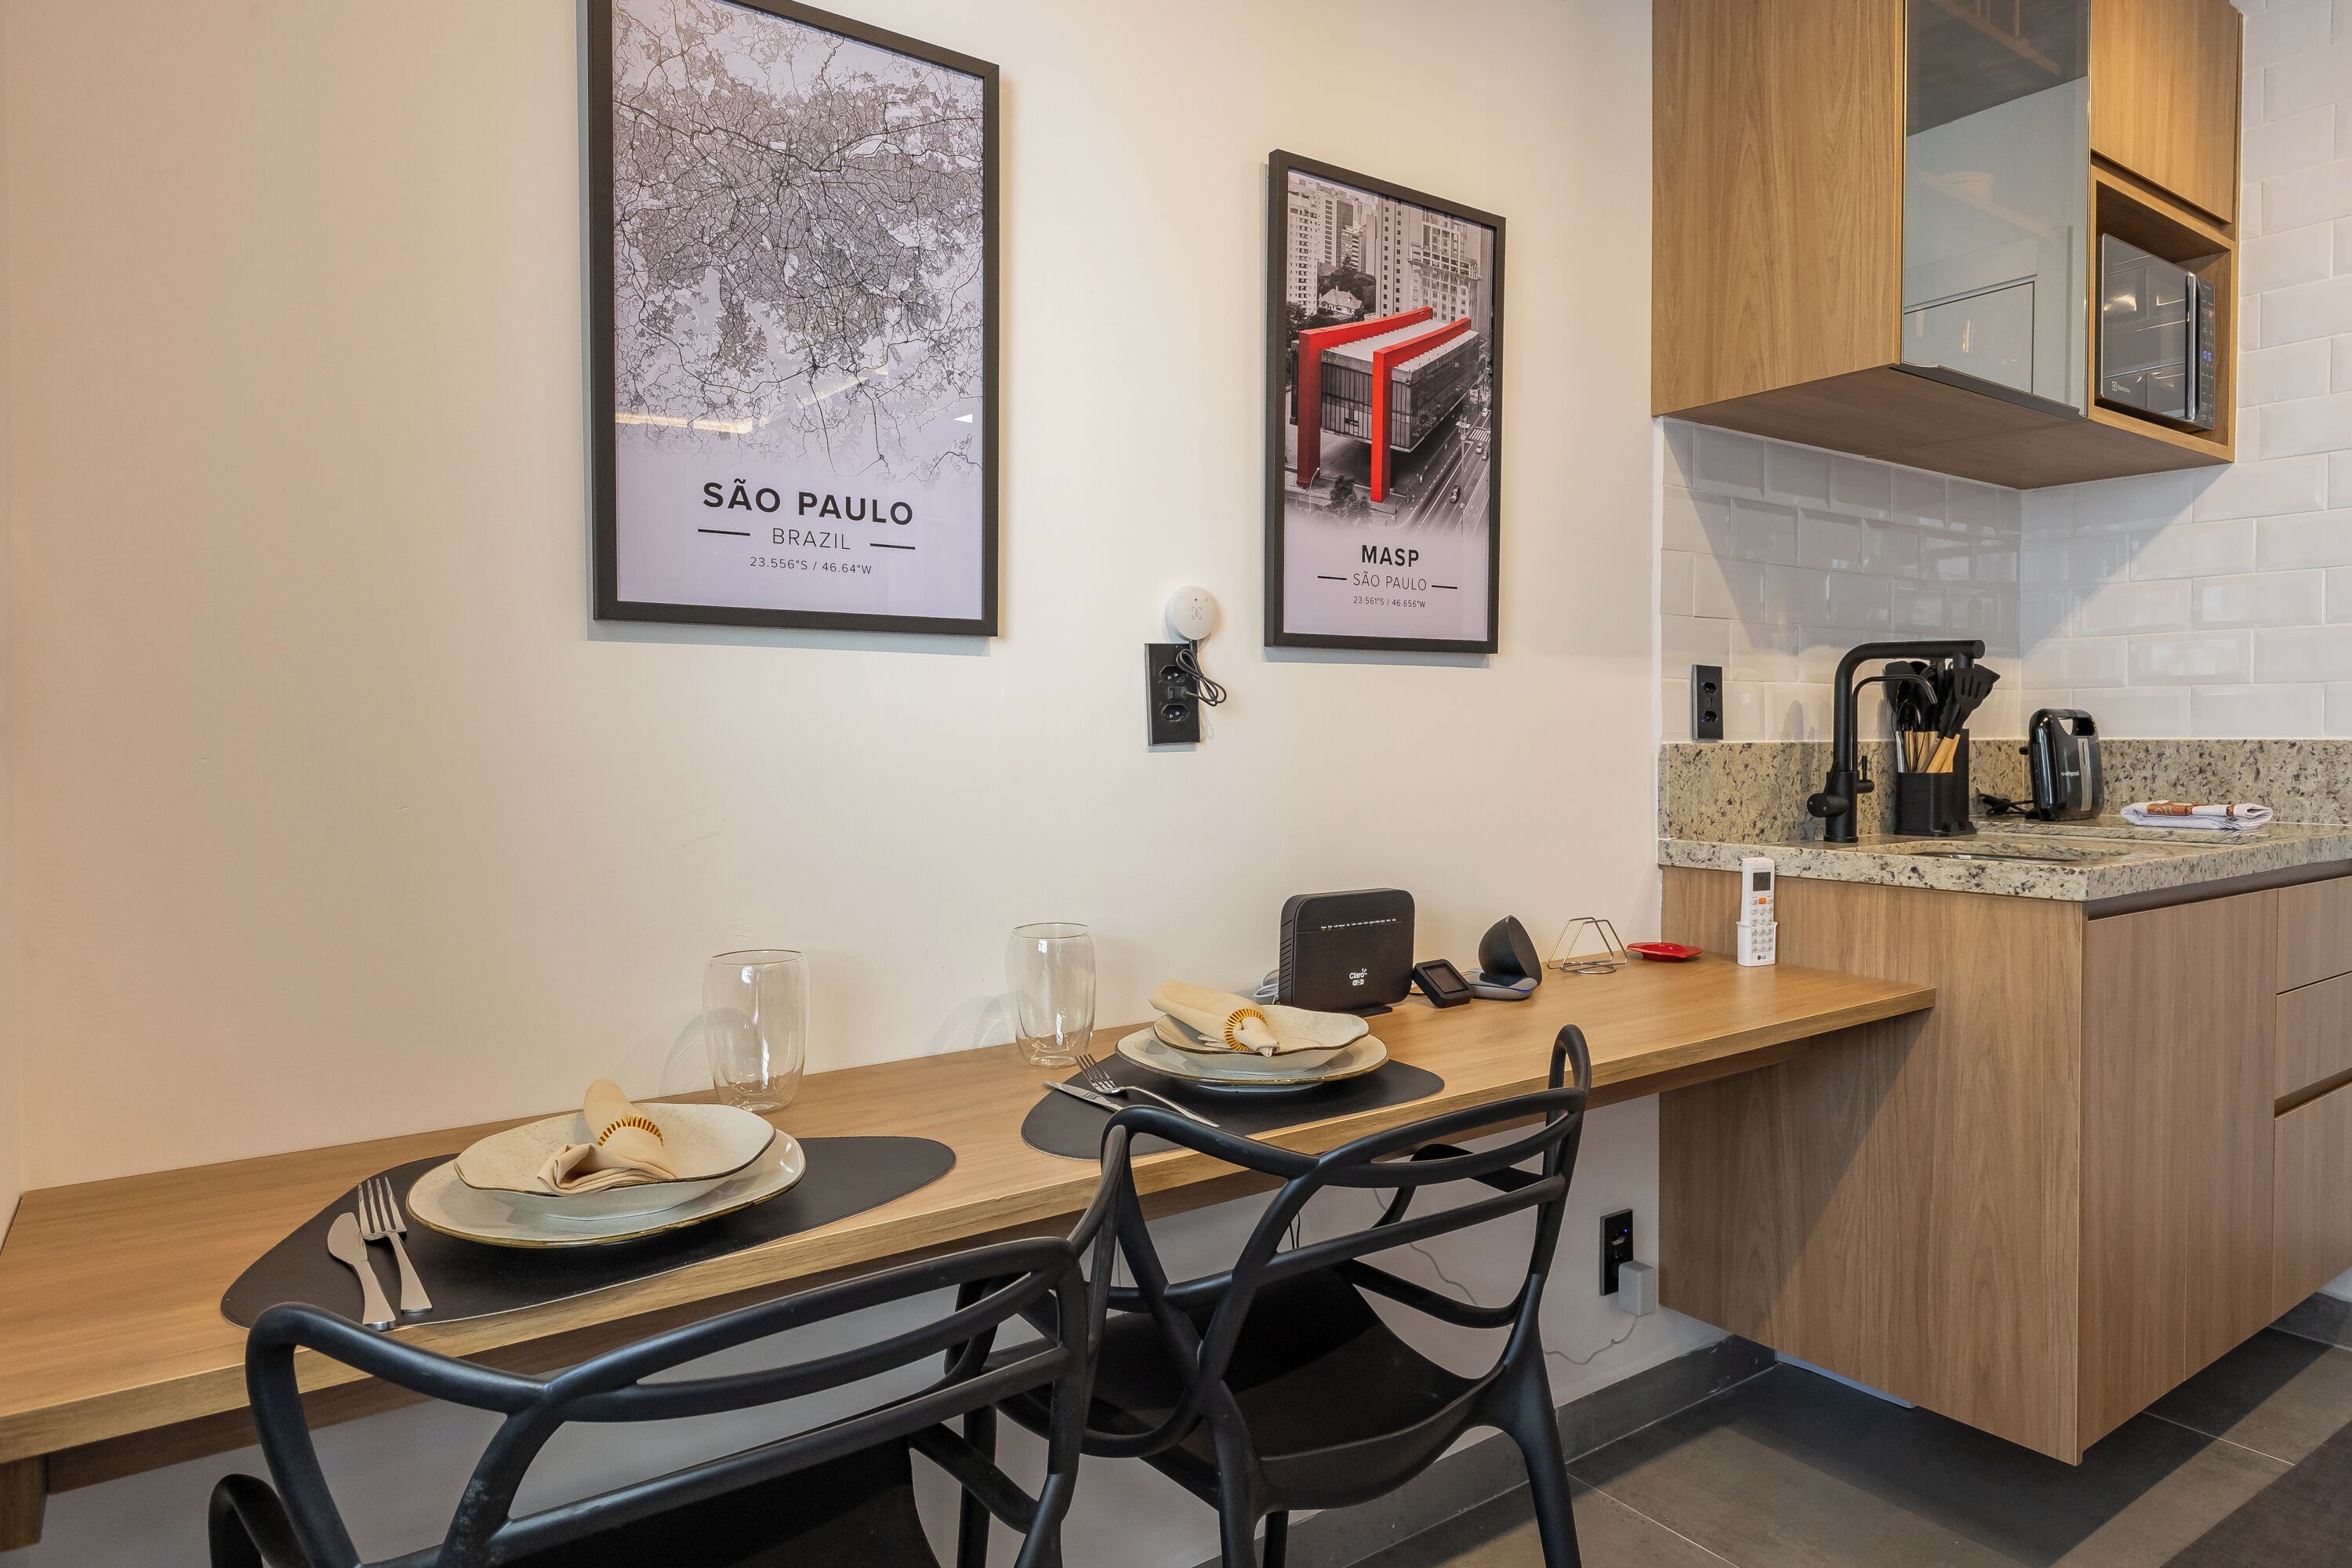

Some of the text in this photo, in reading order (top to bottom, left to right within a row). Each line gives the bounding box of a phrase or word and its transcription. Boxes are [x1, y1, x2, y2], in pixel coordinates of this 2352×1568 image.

[703, 478, 913, 525] SÃO PAULO
[773, 528, 851, 550] BRAZIL
[750, 556, 872, 575] 23.556°S / 46.64°W
[1362, 544, 1419, 567] MASP
[1353, 571, 1427, 591] SÃO PAULO
